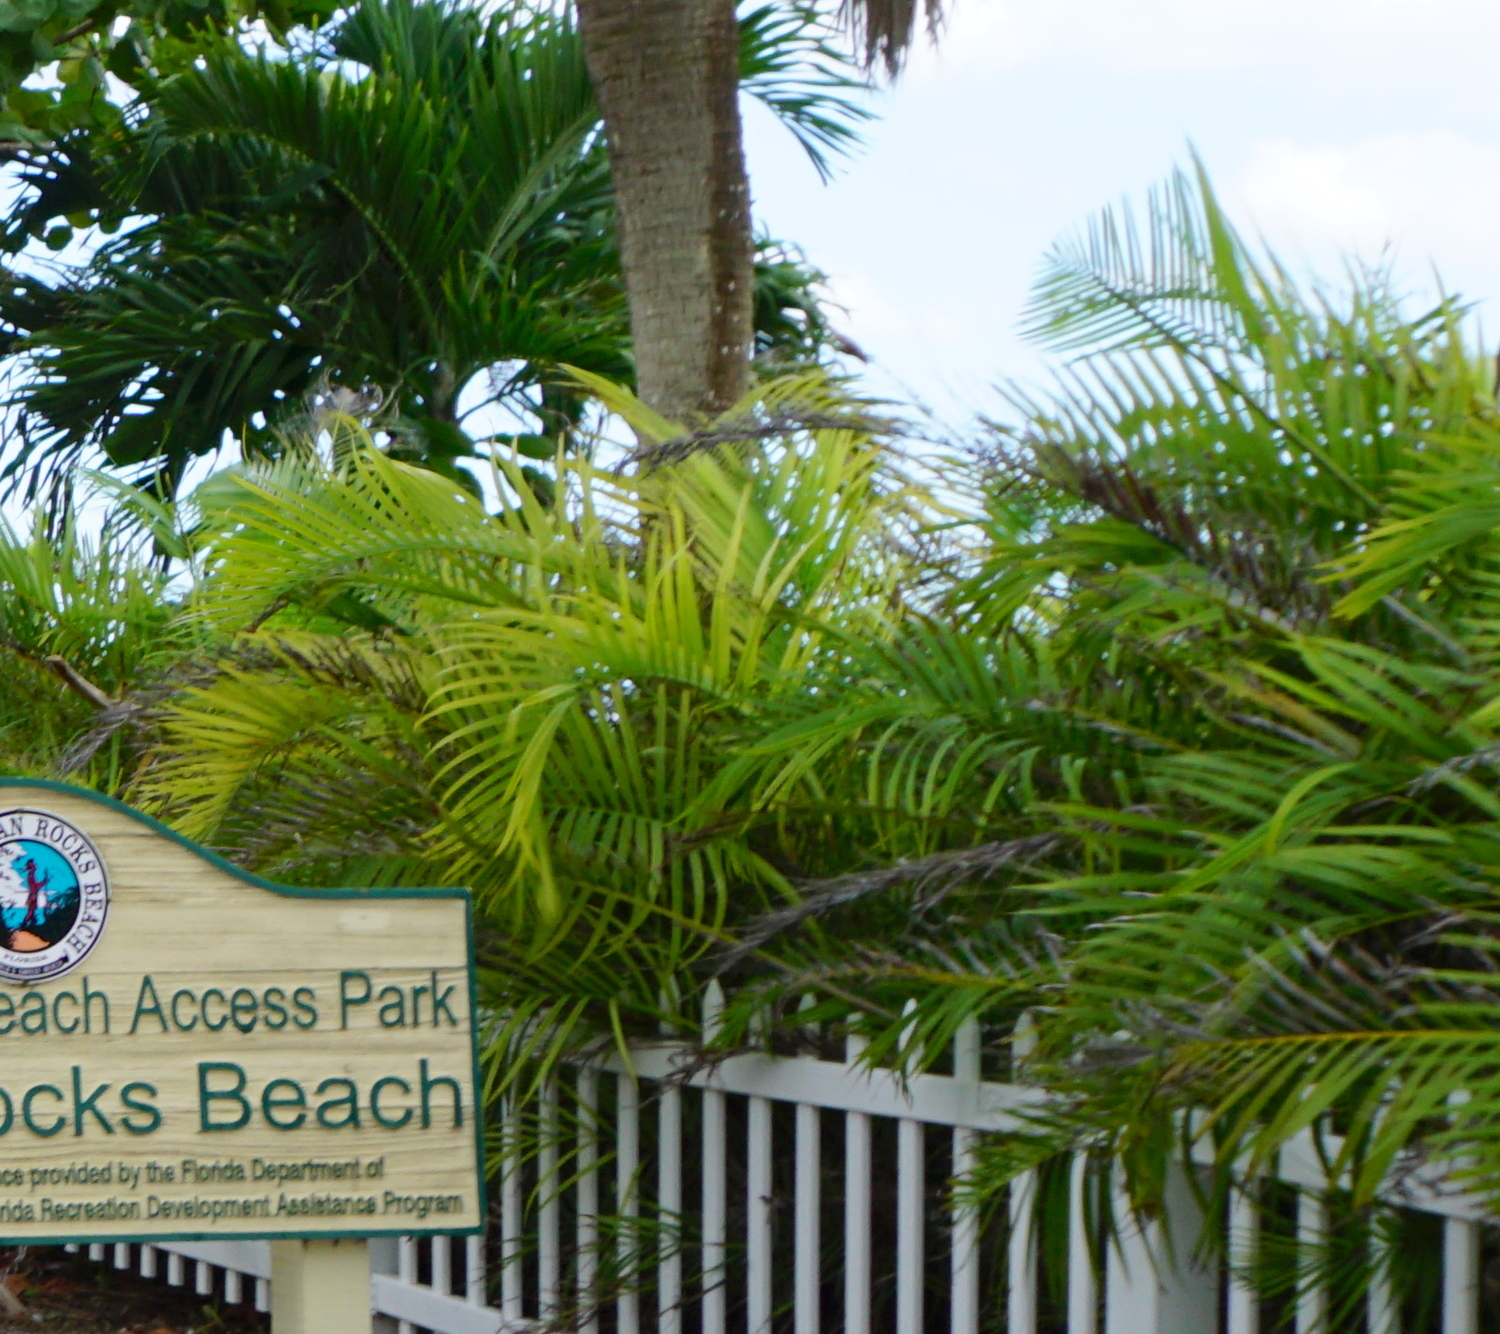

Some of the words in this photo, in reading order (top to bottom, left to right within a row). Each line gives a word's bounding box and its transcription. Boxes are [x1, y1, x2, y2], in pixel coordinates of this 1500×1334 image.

[34, 818, 96, 875] ROCKS
[66, 883, 102, 954] BEACH
[128, 973, 319, 1035] Access
[339, 969, 458, 1031] Park
[199, 1057, 464, 1134] Beach
[30, 1161, 112, 1191] provided
[117, 1161, 141, 1190] by
[146, 1161, 175, 1183] the
[181, 1159, 246, 1183] Florida
[252, 1157, 360, 1186] Department
[366, 1155, 386, 1179] of
[40, 1196, 140, 1221] Recreation
[147, 1194, 271, 1224] Development
[276, 1192, 376, 1216] Assistance
[382, 1190, 463, 1219] Program
